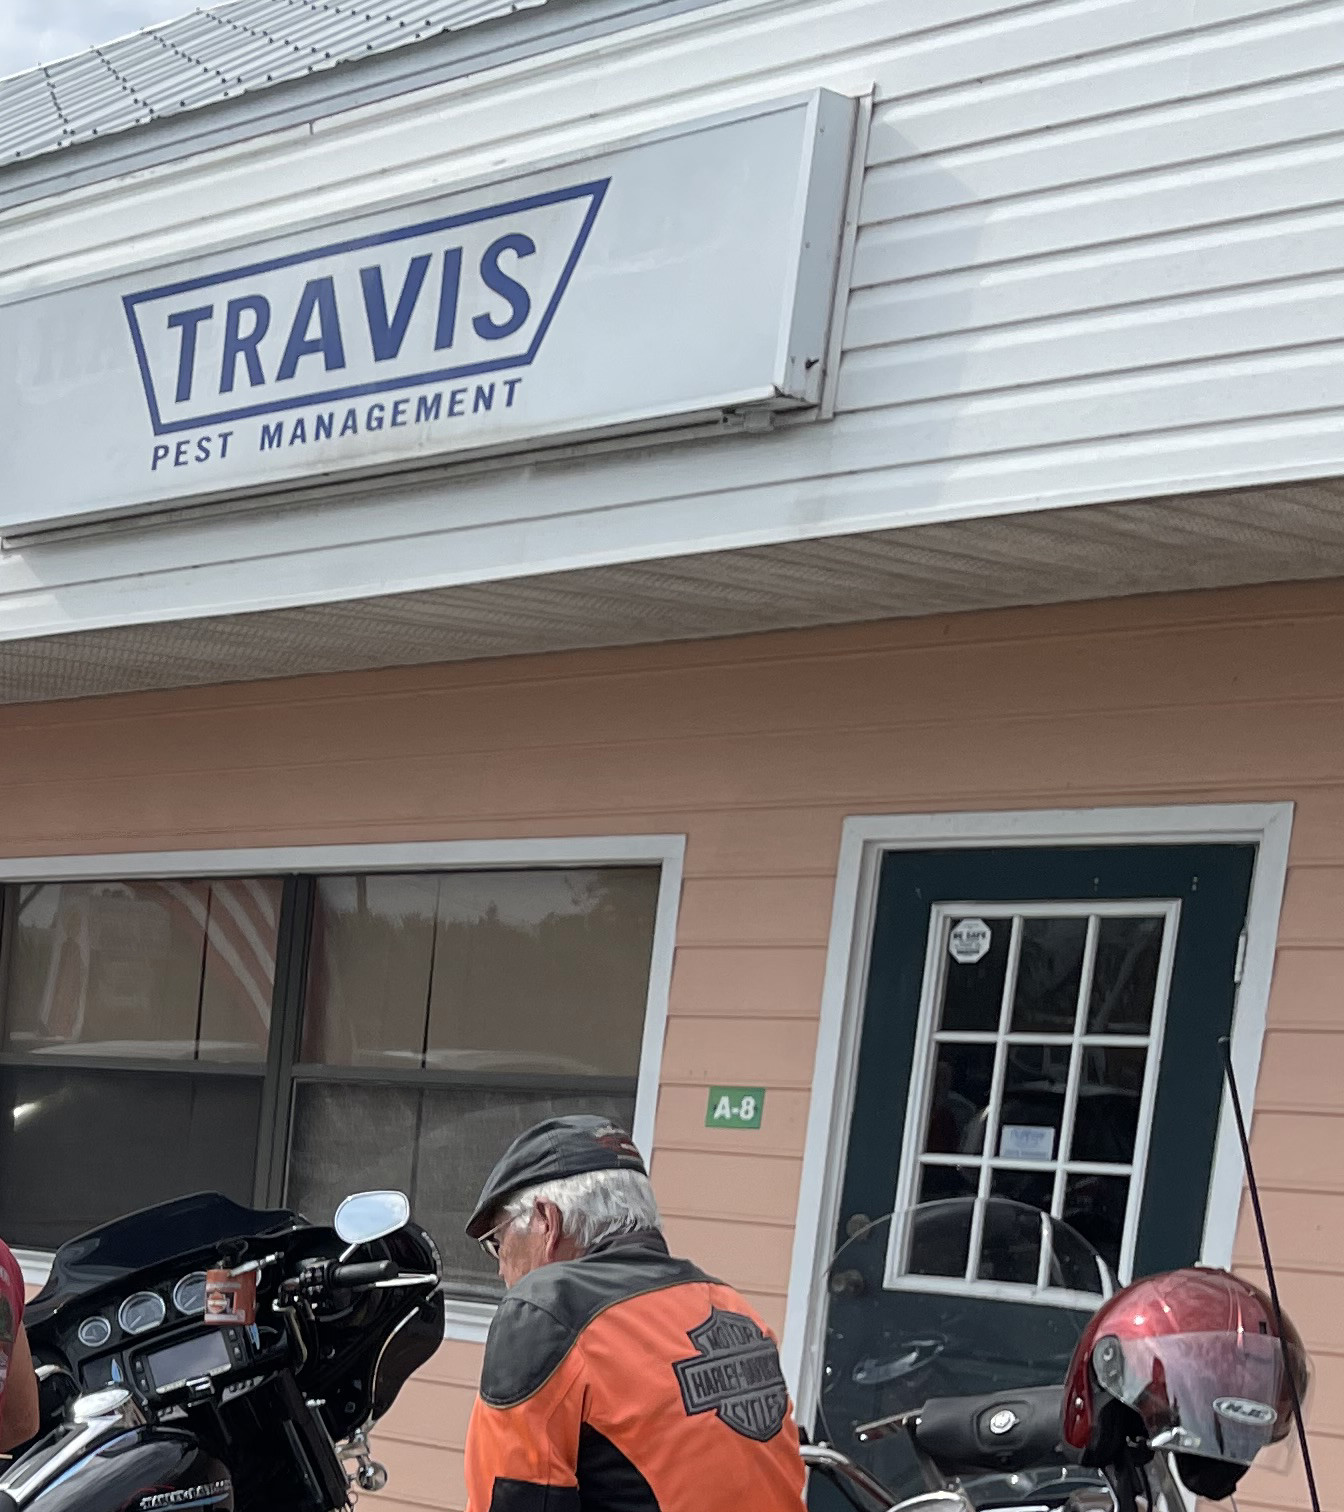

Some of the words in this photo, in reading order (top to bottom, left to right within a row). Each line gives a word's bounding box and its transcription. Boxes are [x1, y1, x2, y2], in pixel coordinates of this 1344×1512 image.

[167, 232, 538, 404] TRAVIS
[150, 430, 234, 471] PEST
[259, 378, 524, 452] MANAGEMENT
[713, 1095, 756, 1121] A-8
